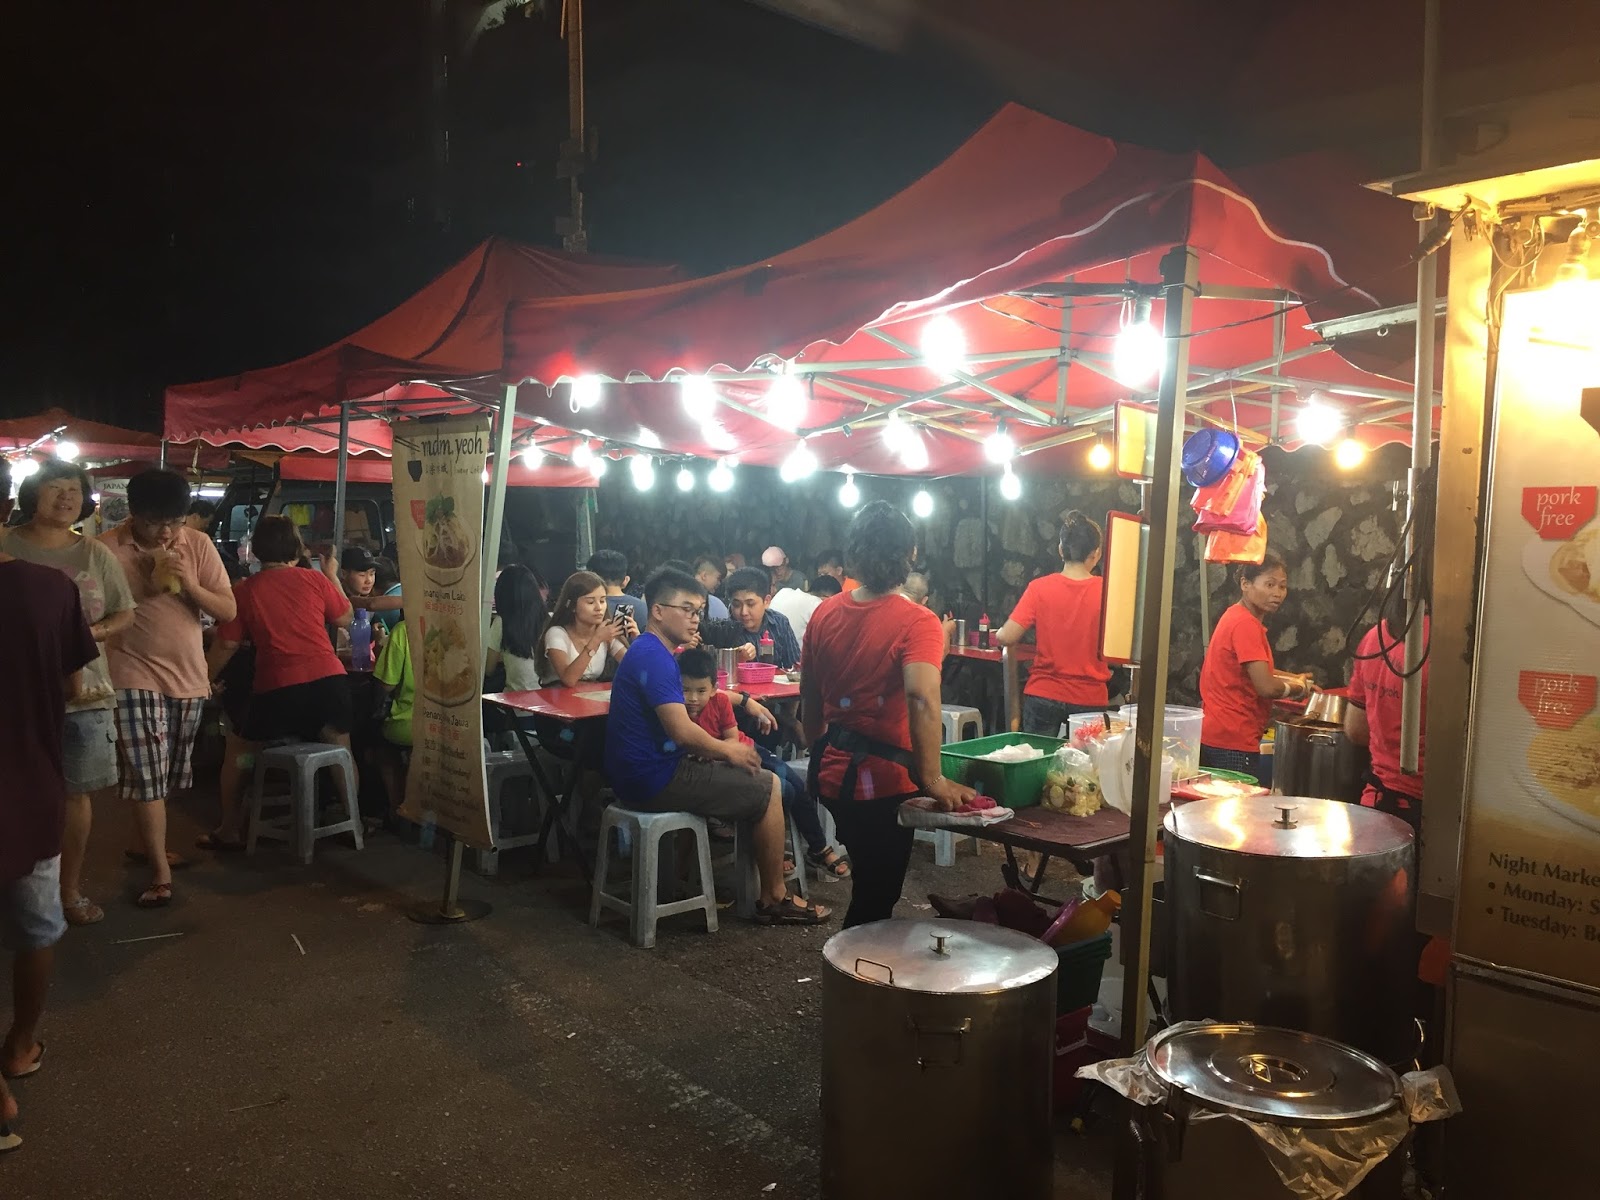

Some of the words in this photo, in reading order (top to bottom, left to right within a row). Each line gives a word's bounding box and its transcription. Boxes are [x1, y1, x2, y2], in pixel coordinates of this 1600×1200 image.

[1536, 485, 1582, 512] pork
[1536, 505, 1575, 533] free
[1534, 673, 1580, 696] pork
[1531, 690, 1574, 719] free
[1488, 852, 1538, 877] Night
[1503, 881, 1583, 914] Monday:
[1501, 905, 1577, 940] Tuesday:
